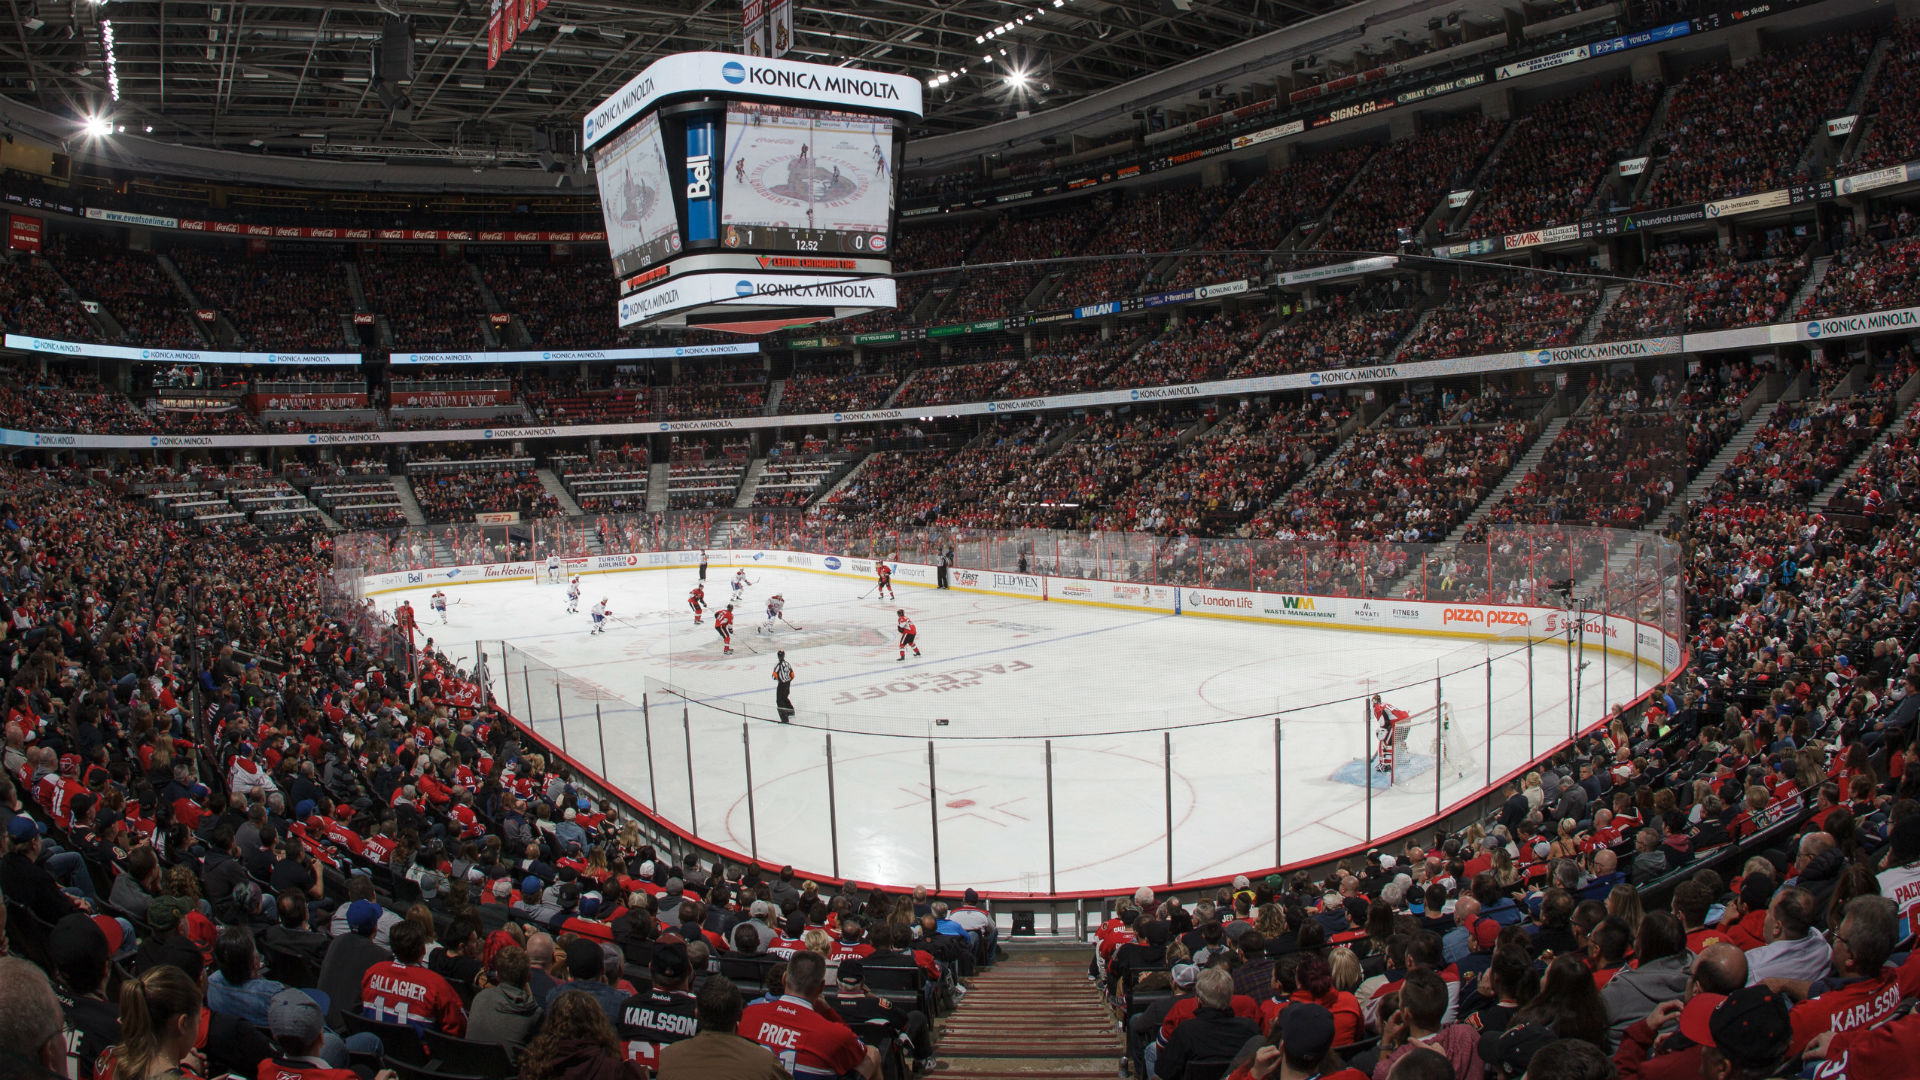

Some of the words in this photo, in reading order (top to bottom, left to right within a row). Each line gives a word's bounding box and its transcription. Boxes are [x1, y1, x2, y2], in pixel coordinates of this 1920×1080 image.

[1628, 32, 1651, 46] YOW.CA
[1516, 57, 1543, 70] ACCESS
[1543, 49, 1575, 63] RIGGING
[1529, 58, 1564, 72] SERVICES
[749, 66, 821, 90] KONICA
[825, 76, 899, 101] MINOLTA
[595, 103, 621, 133] KONICA
[621, 77, 655, 113] MINOLTA
[1330, 99, 1376, 123] SIGNS.CA
[686, 154, 711, 199] Bell
[106, 211, 175, 228] www.eventsonline.ca
[1642, 214, 1671, 227] hundred
[1672, 210, 1703, 223] answers
[747, 230, 753, 245] 1
[1542, 224, 1579, 237] Hallmark
[1542, 234, 1561, 243] Realty
[1561, 232, 1579, 242] Group
[796, 239, 819, 251] 12:52
[855, 235, 863, 250] 0
[1505, 233, 1541, 248] RE/MAX
[841, 259, 857, 270] TIRE
[756, 282, 810, 297] KONICA
[815, 284, 875, 299] MINOLTA
[630, 300, 651, 316] KONICA
[652, 289, 680, 309] MINOLTA
[1081, 302, 1113, 318] WiLAN
[1823, 318, 1866, 335] KONICA
[1867, 311, 1917, 331] MINOLTA
[40, 341, 58, 351] KONICA
[59, 345, 82, 354] MINOLTA
[684, 347, 709, 356] KONICA
[711, 345, 739, 354] MINOLTA
[1552, 346, 1596, 363] KONICA
[1598, 342, 1646, 359] MINOLTA
[150, 350, 174, 360] KONICA
[175, 351, 200, 361] MINOLTA
[277, 354, 301, 363] KONICA
[302, 355, 331, 363] MINOLTA
[419, 354, 444, 362] KONICA
[445, 353, 473, 361] MINOLTA
[551, 352, 576, 360] KONICA
[577, 351, 605, 360] MINOLTA
[1321, 370, 1356, 383] KONICA
[1356, 367, 1398, 380] MINOLTA
[1139, 388, 1170, 400] KONICA
[1171, 385, 1200, 398] MINOLTA
[996, 402, 1020, 412] KONICA
[1020, 399, 1046, 409] MINOLTA
[843, 412, 871, 421] KONICA
[872, 410, 902, 420] MINOLTA
[670, 421, 698, 431] KONICA
[700, 418, 733, 429] MINOLTA
[318, 433, 347, 443] KONICA
[348, 432, 380, 442] MINOLTA
[494, 429, 523, 438] KONICA
[524, 427, 557, 437] MINOLTA
[40, 435, 58, 445] KONICA
[58, 435, 76, 445] MINOLTA
[159, 436, 183, 446] KONICA
[184, 436, 213, 446] MINOLTA
[483, 513, 512, 524] TSN
[598, 555, 627, 563] TURKISH
[598, 561, 627, 569] AIRLINES
[649, 554, 671, 565] IBM
[679, 552, 700, 564] IBM
[484, 565, 501, 578] Tim
[501, 563, 535, 577] Hortons
[961, 572, 979, 581] FIRST
[408, 572, 423, 585] Bell
[960, 578, 978, 588] SHIFT
[1202, 594, 1236, 609] London
[1236, 596, 1253, 609] Life
[1281, 595, 1316, 611] WM
[1264, 608, 1286, 616] WASTE
[1286, 609, 1337, 619] MANAGEMENT
[1354, 610, 1380, 618] MOVATI
[1392, 608, 1420, 617] FITNESS
[1443, 607, 1484, 626] pizza
[1486, 610, 1529, 628] pizza
[832, 660, 1034, 706] FACE-OFF
[370, 973, 427, 1002] GALLAGHER
[374, 994, 409, 1025] 11
[1830, 982, 1901, 1033] KARLSSON
[624, 1006, 698, 1037] KARLSSON
[757, 1021, 801, 1050] PRICE
